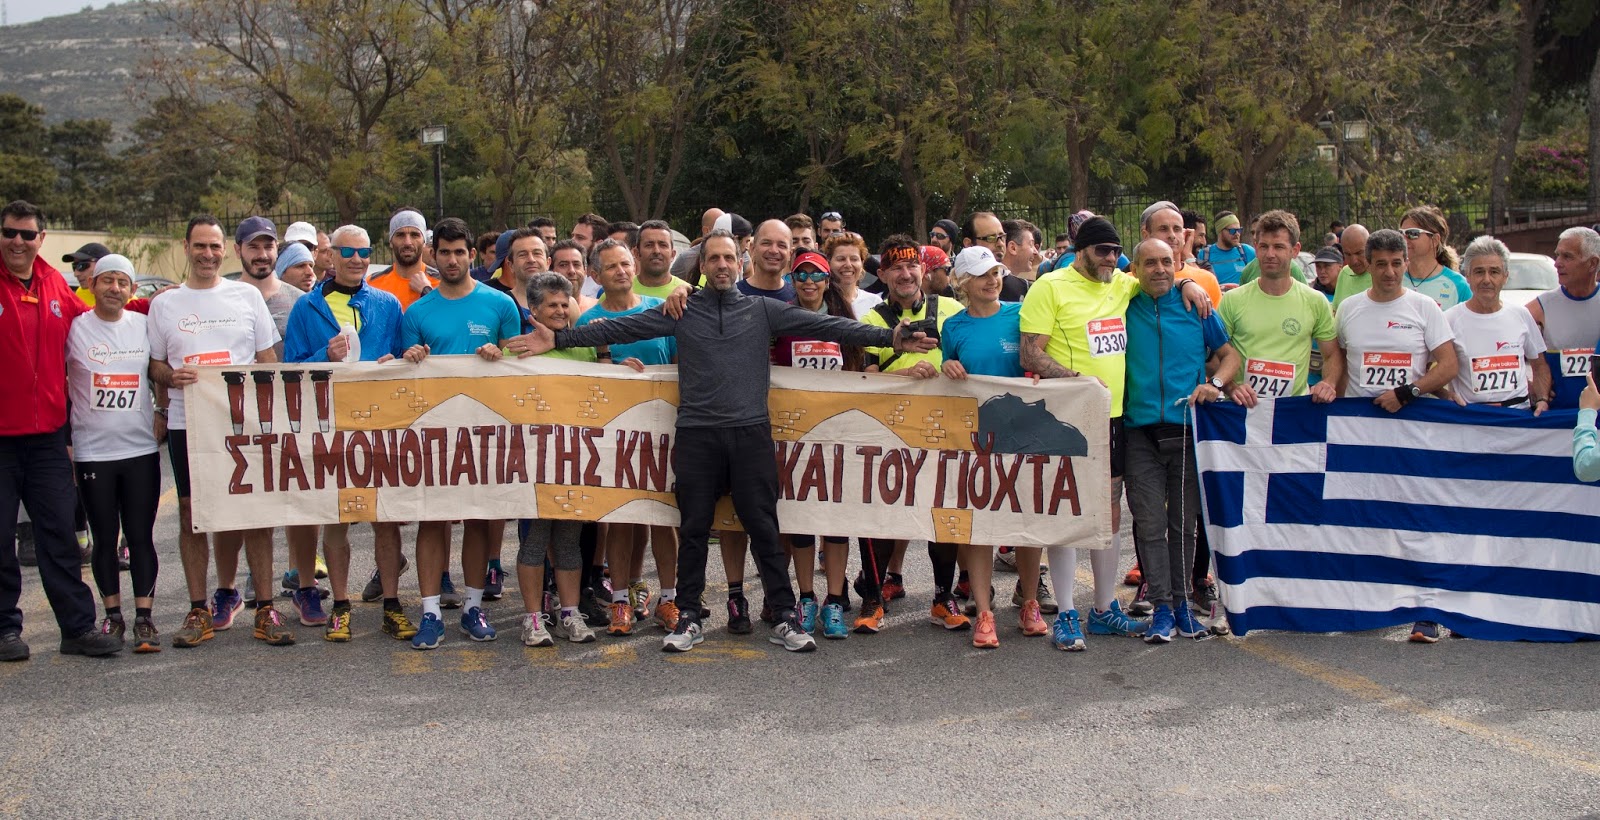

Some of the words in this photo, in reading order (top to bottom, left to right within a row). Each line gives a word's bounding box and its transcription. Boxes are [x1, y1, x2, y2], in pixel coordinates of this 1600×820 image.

[1094, 333, 1126, 354] 2330
[1274, 367, 1293, 376] balance
[1366, 367, 1407, 386] 2243
[1477, 370, 1518, 392] 2274
[1249, 375, 1290, 397] 2247
[96, 389, 137, 409] 2267
[225, 433, 310, 494] ΣΤΑ
[311, 425, 528, 489] ΜΟΝΟΠΑΤΙΑ
[529, 425, 604, 488] ΤΗΣ
[776, 440, 845, 504] ΚΑΙ
[855, 445, 929, 507] ΤΟΥ
